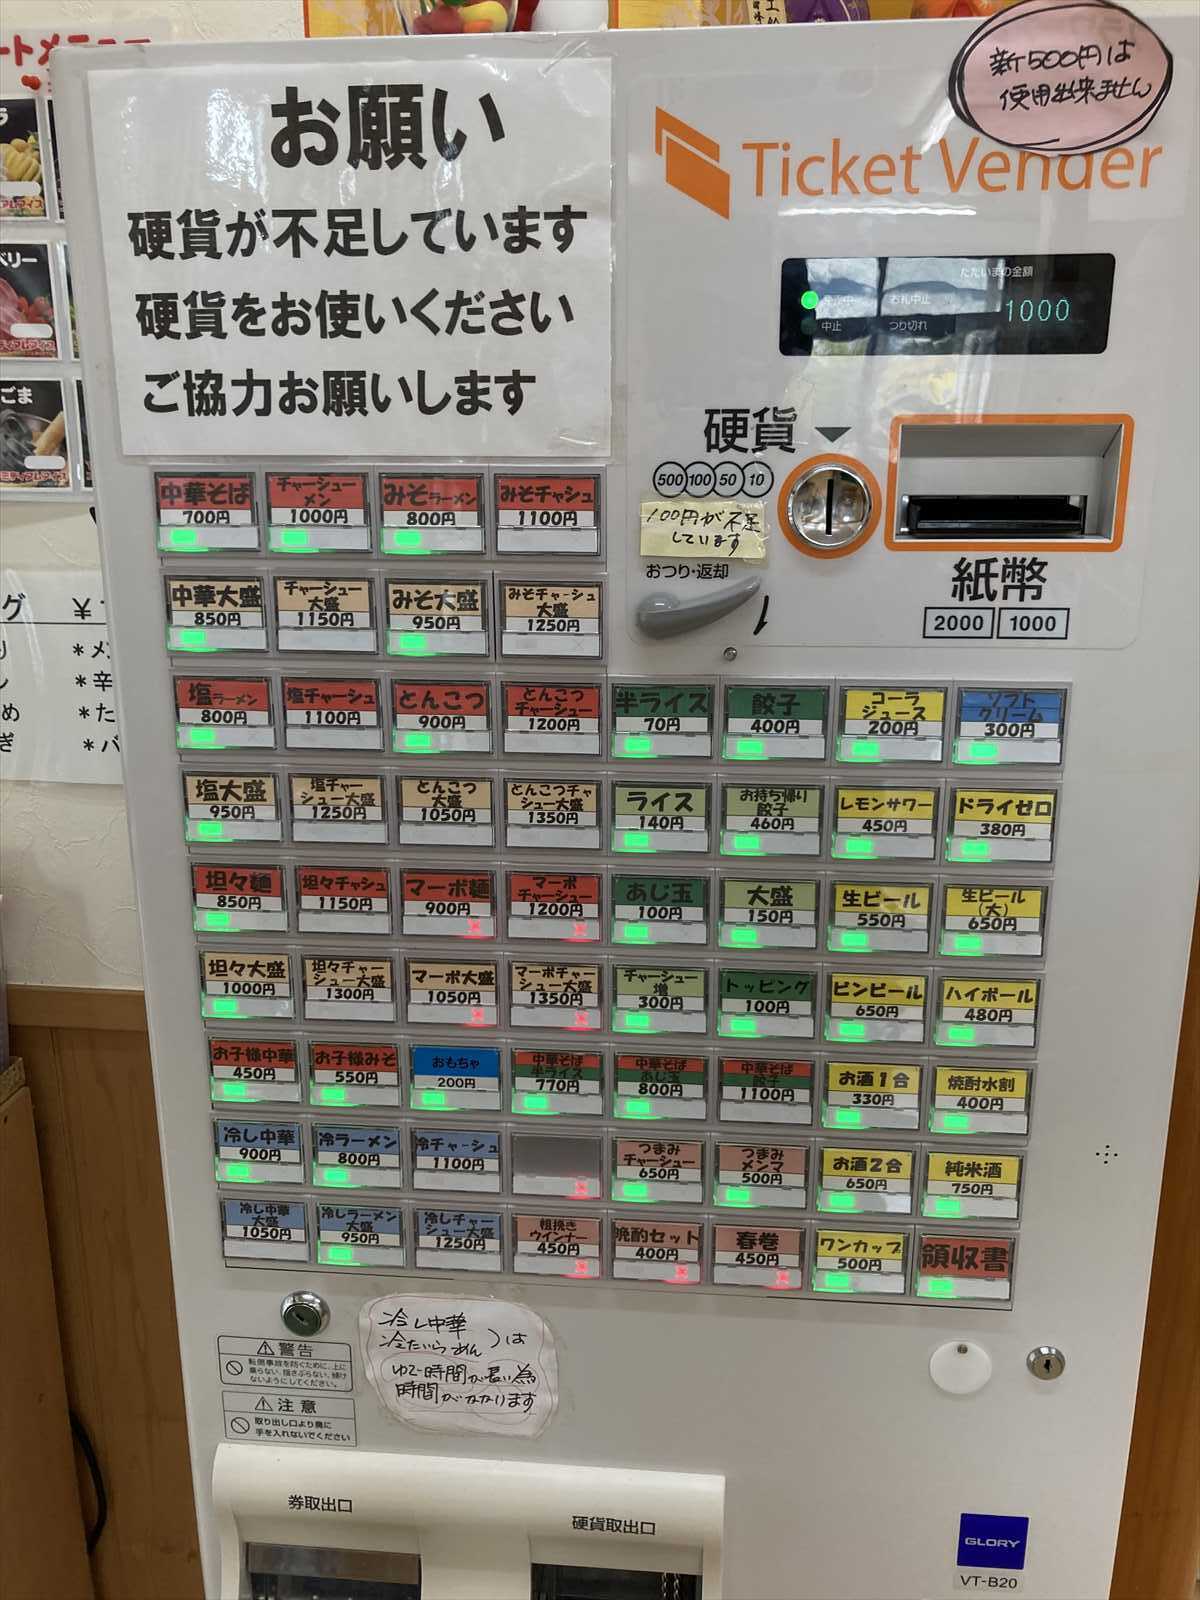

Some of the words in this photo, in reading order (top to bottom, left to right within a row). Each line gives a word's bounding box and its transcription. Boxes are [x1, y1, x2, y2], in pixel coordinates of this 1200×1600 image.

[271, 84, 505, 170] お願い
[742, 138, 922, 198] Ticket
[127, 204, 587, 260] 硬貨が不足しています
[135, 287, 574, 340] 硬貨をお使いください
[1006, 299, 1070, 322] 1000
[821, 321, 841, 331] 中止
[889, 320, 927, 330] つり切れ
[143, 368, 536, 417] ご協力お願いします
[704, 407, 796, 454] 硬貨
[276, 477, 356, 493] チャーシュー
[658, 474, 684, 486] 500
[689, 474, 711, 486] 100
[720, 474, 736, 486] 50
[160, 481, 250, 506] 中華そば
[384, 483, 476, 505] みそラーメン
[183, 510, 230, 524] 700円
[291, 509, 348, 523] 1000円
[406, 512, 456, 526] 800円
[519, 511, 577, 526] 1100円
[647, 509, 760, 532] 100円が不足
[673, 531, 741, 556] しています
[951, 557, 1048, 602] 紙幣
[284, 581, 362, 596] チャーシュー
[172, 584, 263, 608] 中華大盛
[392, 589, 479, 612] みそ大盛
[308, 596, 340, 612] 大盛
[537, 602, 568, 618] 大盛
[194, 612, 241, 626] 850円
[297, 612, 354, 626] 1150円
[412, 616, 460, 630] 950円
[528, 619, 580, 632] 1250円
[934, 615, 984, 632] 2000
[1009, 615, 1056, 632] 1000
[189, 683, 258, 706] 塩ラーメン
[400, 689, 484, 710] とんこつ
[523, 688, 584, 701] とんこつ
[872, 692, 920, 706] コーラ
[515, 702, 592, 716] チャーシュー
[616, 691, 707, 713] 半ライス
[201, 710, 247, 724] 800円
[305, 712, 360, 725] 1100円
[862, 706, 926, 720] ジュース
[418, 716, 466, 729] 900円
[529, 718, 580, 731] 1200円
[644, 718, 680, 732] 70円
[751, 719, 800, 734] 400円
[869, 721, 918, 736] 200円
[984, 724, 1035, 738] 300円
[196, 779, 267, 802] 塩大盛
[417, 781, 476, 794] とんこつ
[511, 784, 592, 797] とんこつチャ
[301, 792, 376, 806] シュー大盛
[432, 795, 463, 808] 大盛
[627, 792, 693, 812] ライス
[740, 789, 807, 803] お持ち帰り
[521, 797, 583, 812] シュー大盛
[757, 803, 788, 817] 餃子
[840, 797, 932, 811] レモンサワー
[959, 797, 1051, 816] ドライゼロ
[210, 806, 255, 819] 950円
[312, 806, 367, 820] 1250円
[421, 808, 476, 822] 1050円
[529, 812, 578, 824] 1350円
[639, 816, 683, 829] 140円
[751, 818, 794, 830] 460円
[862, 820, 907, 832] 450円
[980, 824, 1025, 836] 380円
[206, 871, 272, 893] 坦々麺
[626, 882, 693, 903] あじ玉
[747, 885, 793, 907] 大盛
[842, 890, 920, 908] 生ビール
[962, 888, 1025, 903] 生ビール
[217, 896, 261, 910] 850円
[319, 897, 372, 910] 1150円
[426, 902, 470, 915] 900円
[529, 903, 583, 916] 1200円
[639, 907, 682, 920] 100円
[749, 910, 793, 923] 150円
[857, 914, 905, 928] 550円
[968, 917, 1017, 931] 650円
[208, 960, 286, 979] 坦々大盛
[313, 974, 385, 988] シュー大盛
[624, 970, 698, 984] チャーシュー
[223, 983, 275, 996] 1000円
[519, 979, 592, 993] シュー大盛
[326, 988, 374, 1000] 1300円
[428, 991, 481, 1004] 1050円
[530, 992, 583, 1006] 1350円
[946, 986, 1033, 1003] ハイボール
[639, 997, 683, 1009] 300円
[745, 1000, 790, 1014] 100円
[856, 1006, 898, 1018] 650円
[965, 1008, 1013, 1022] 480円
[214, 1047, 296, 1062] お子様中華
[316, 1051, 396, 1066] お子様みそ
[432, 1057, 480, 1069] おもちゃ
[233, 1068, 275, 1080] 450円
[336, 1071, 378, 1084] 550円
[438, 1077, 476, 1088] 200円
[536, 1079, 579, 1093] 770円
[639, 1083, 683, 1096] 800円
[948, 1076, 1016, 1092] 焼酎水割
[741, 1088, 794, 1101] 1100円
[852, 1094, 894, 1106] 330円
[957, 1097, 1004, 1110] 400円
[224, 1127, 295, 1145] 冷し中華
[319, 1132, 397, 1148] 冷ラーメン
[239, 1148, 281, 1161] 900円
[638, 1143, 680, 1156] つまみ
[742, 1148, 784, 1161] つまみ
[338, 1153, 380, 1166] 800円
[434, 1158, 484, 1170] 1100円
[624, 1154, 695, 1168] チャーシュー
[742, 1160, 784, 1172] メンマ
[639, 1169, 679, 1180] 650円
[945, 1161, 1002, 1179] 純米酒
[742, 1174, 782, 1185] 500円
[846, 1178, 887, 1191] 650円
[952, 1183, 993, 1195] 750円
[251, 1215, 279, 1227] 大盛
[346, 1221, 373, 1232] 大盛
[242, 1226, 291, 1241] 1050円
[341, 1232, 379, 1244] 950円
[426, 1224, 495, 1239] シュー大盛
[616, 1227, 699, 1245] 晩酌セット
[435, 1237, 486, 1250] 1250円
[736, 1232, 779, 1250] 春巻
[820, 1238, 903, 1254] ワンカップ
[537, 1242, 580, 1255] 450円
[636, 1247, 678, 1261] 400円
[736, 1253, 779, 1265] 450円
[838, 1259, 882, 1271] 500円
[922, 1244, 1008, 1272] 領収書
[378, 1308, 466, 1339] 冷し中華
[288, 1494, 352, 1513] 券取出口
[573, 1515, 656, 1536] 硬貨取出口
[965, 1537, 1020, 1548] GLORY
[960, 1575, 1018, 1589] VT-B20
